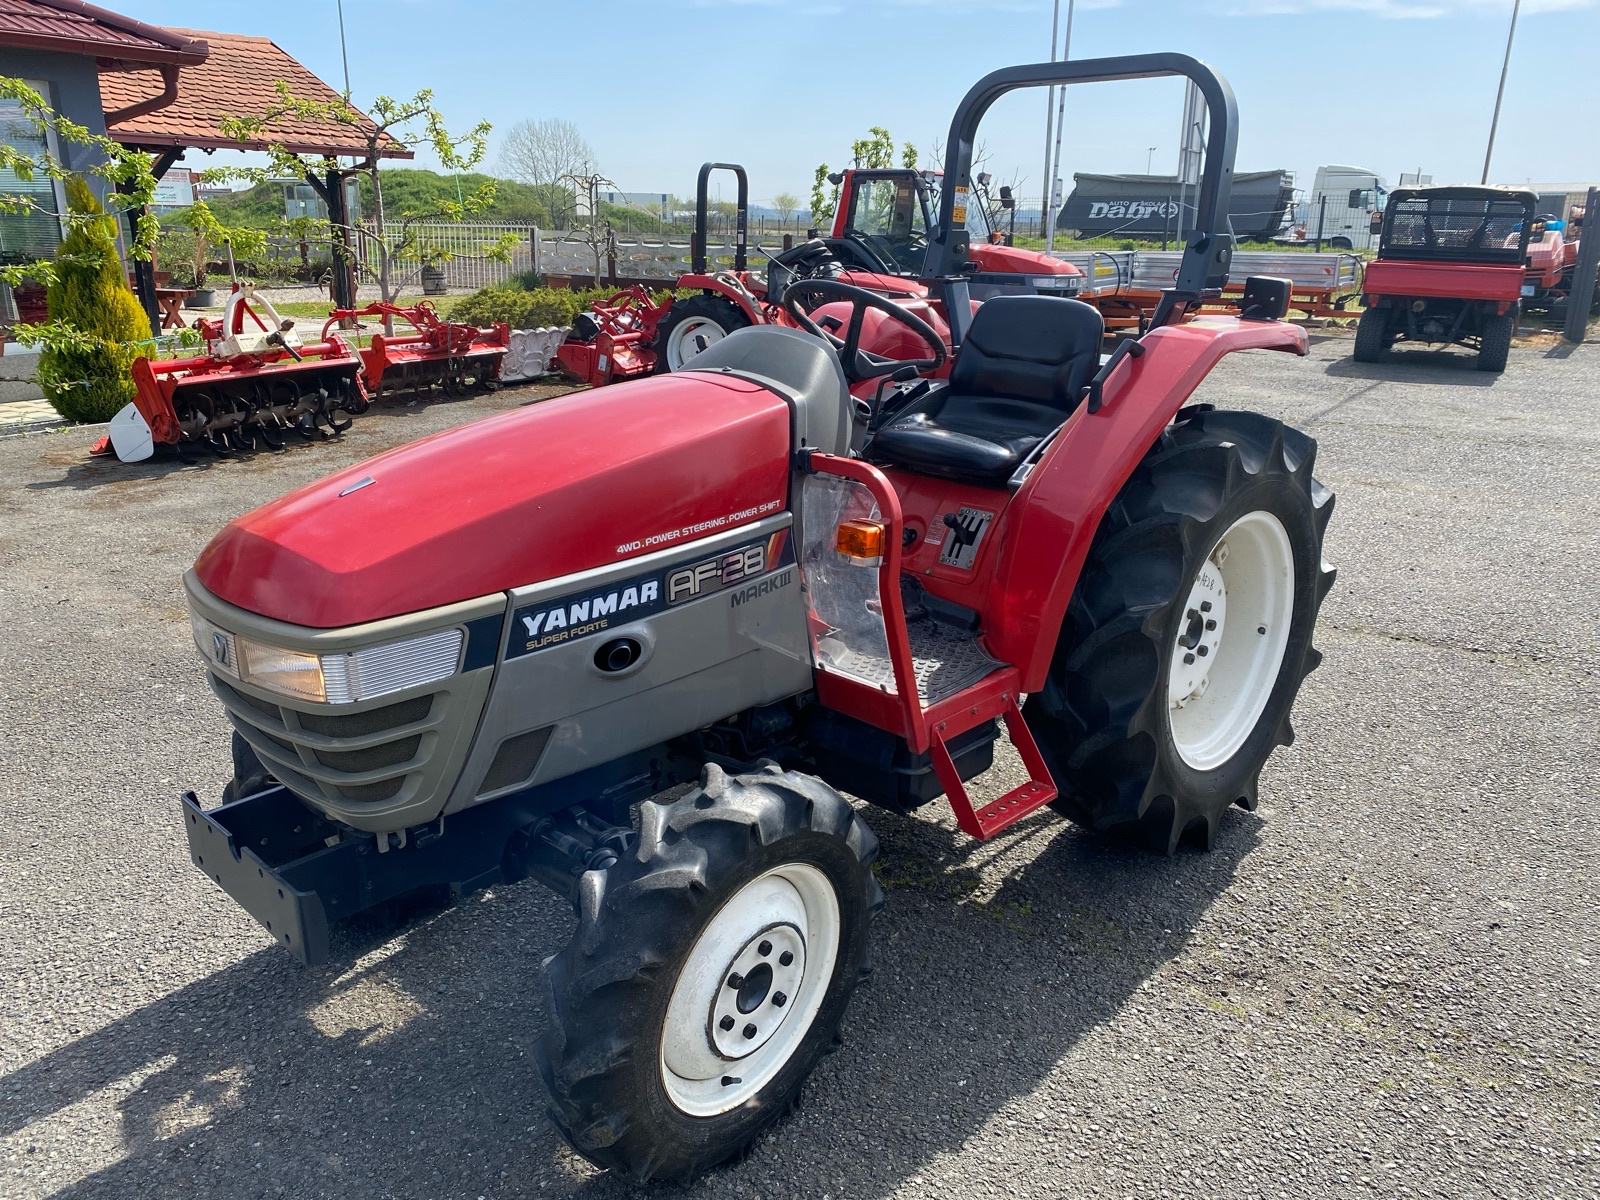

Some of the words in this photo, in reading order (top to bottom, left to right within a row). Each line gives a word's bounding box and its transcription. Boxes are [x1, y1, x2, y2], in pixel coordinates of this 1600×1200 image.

[759, 499, 781, 513] SHIFT
[522, 580, 658, 637] YANMAR
[526, 631, 569, 651] SUPER
[570, 619, 608, 638] FORTE
